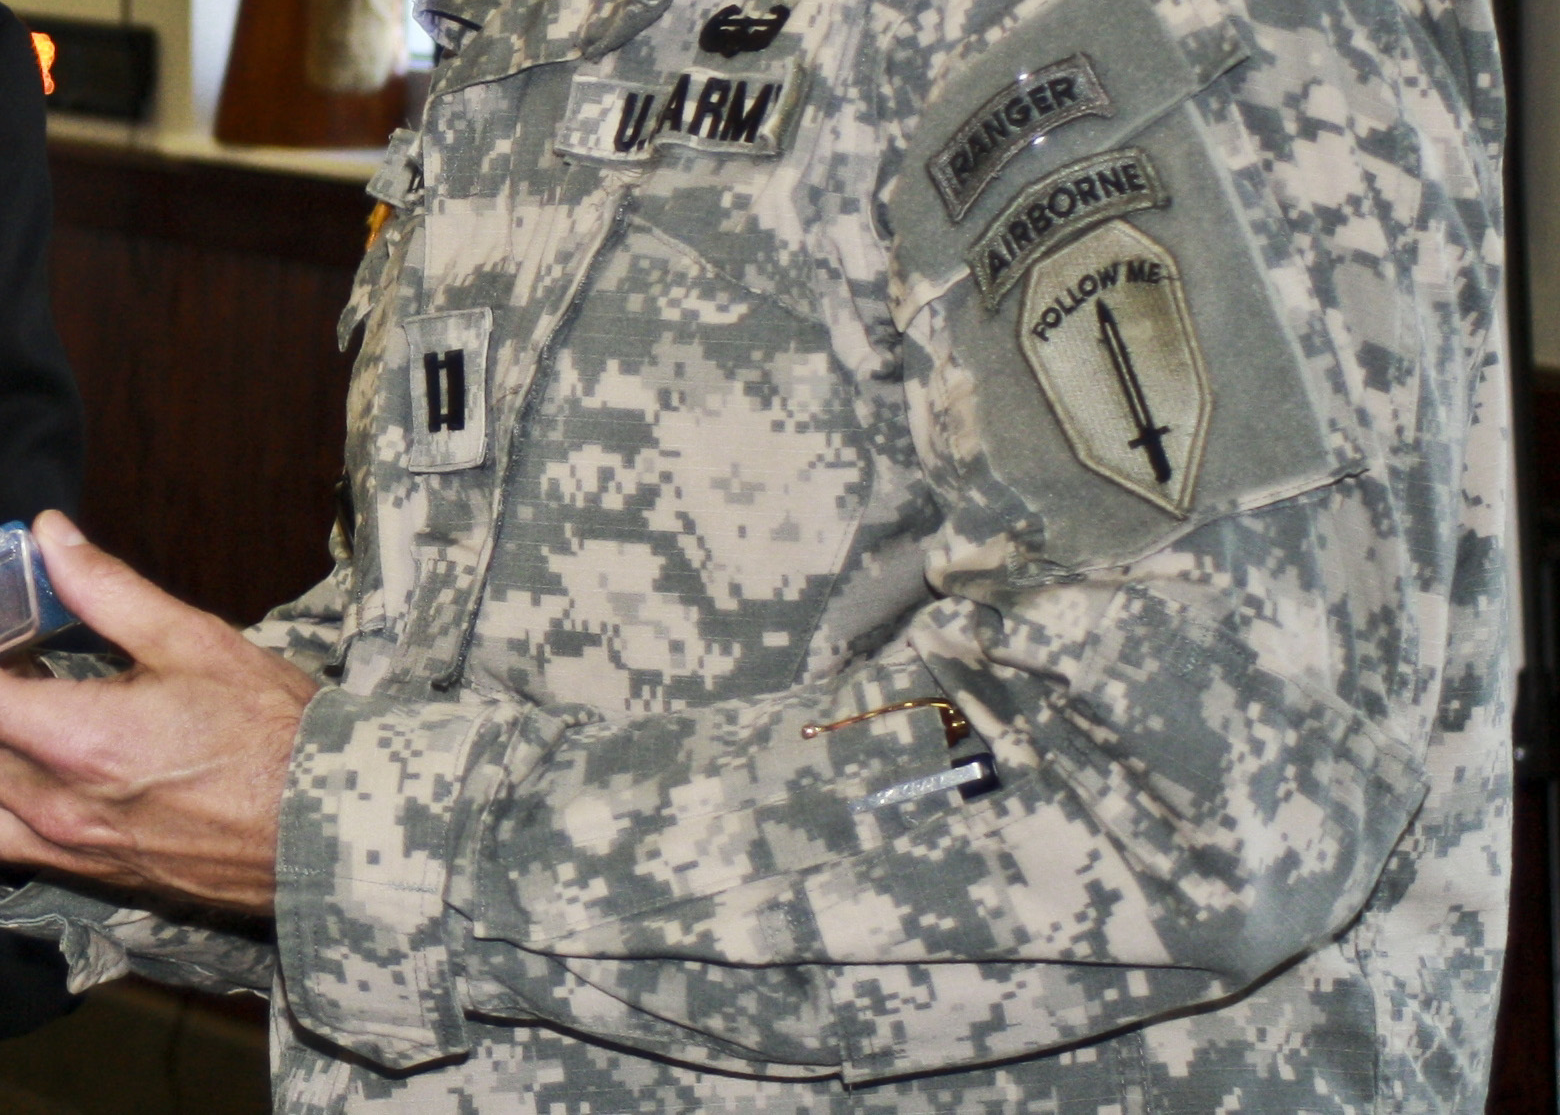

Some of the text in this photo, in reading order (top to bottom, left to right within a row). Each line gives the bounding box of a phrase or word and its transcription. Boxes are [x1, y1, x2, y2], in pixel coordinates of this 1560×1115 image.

[948, 76, 1080, 186] RANGER
[985, 161, 1146, 281] AIRBORNE
[1032, 260, 1164, 342] FOLLOW ME
